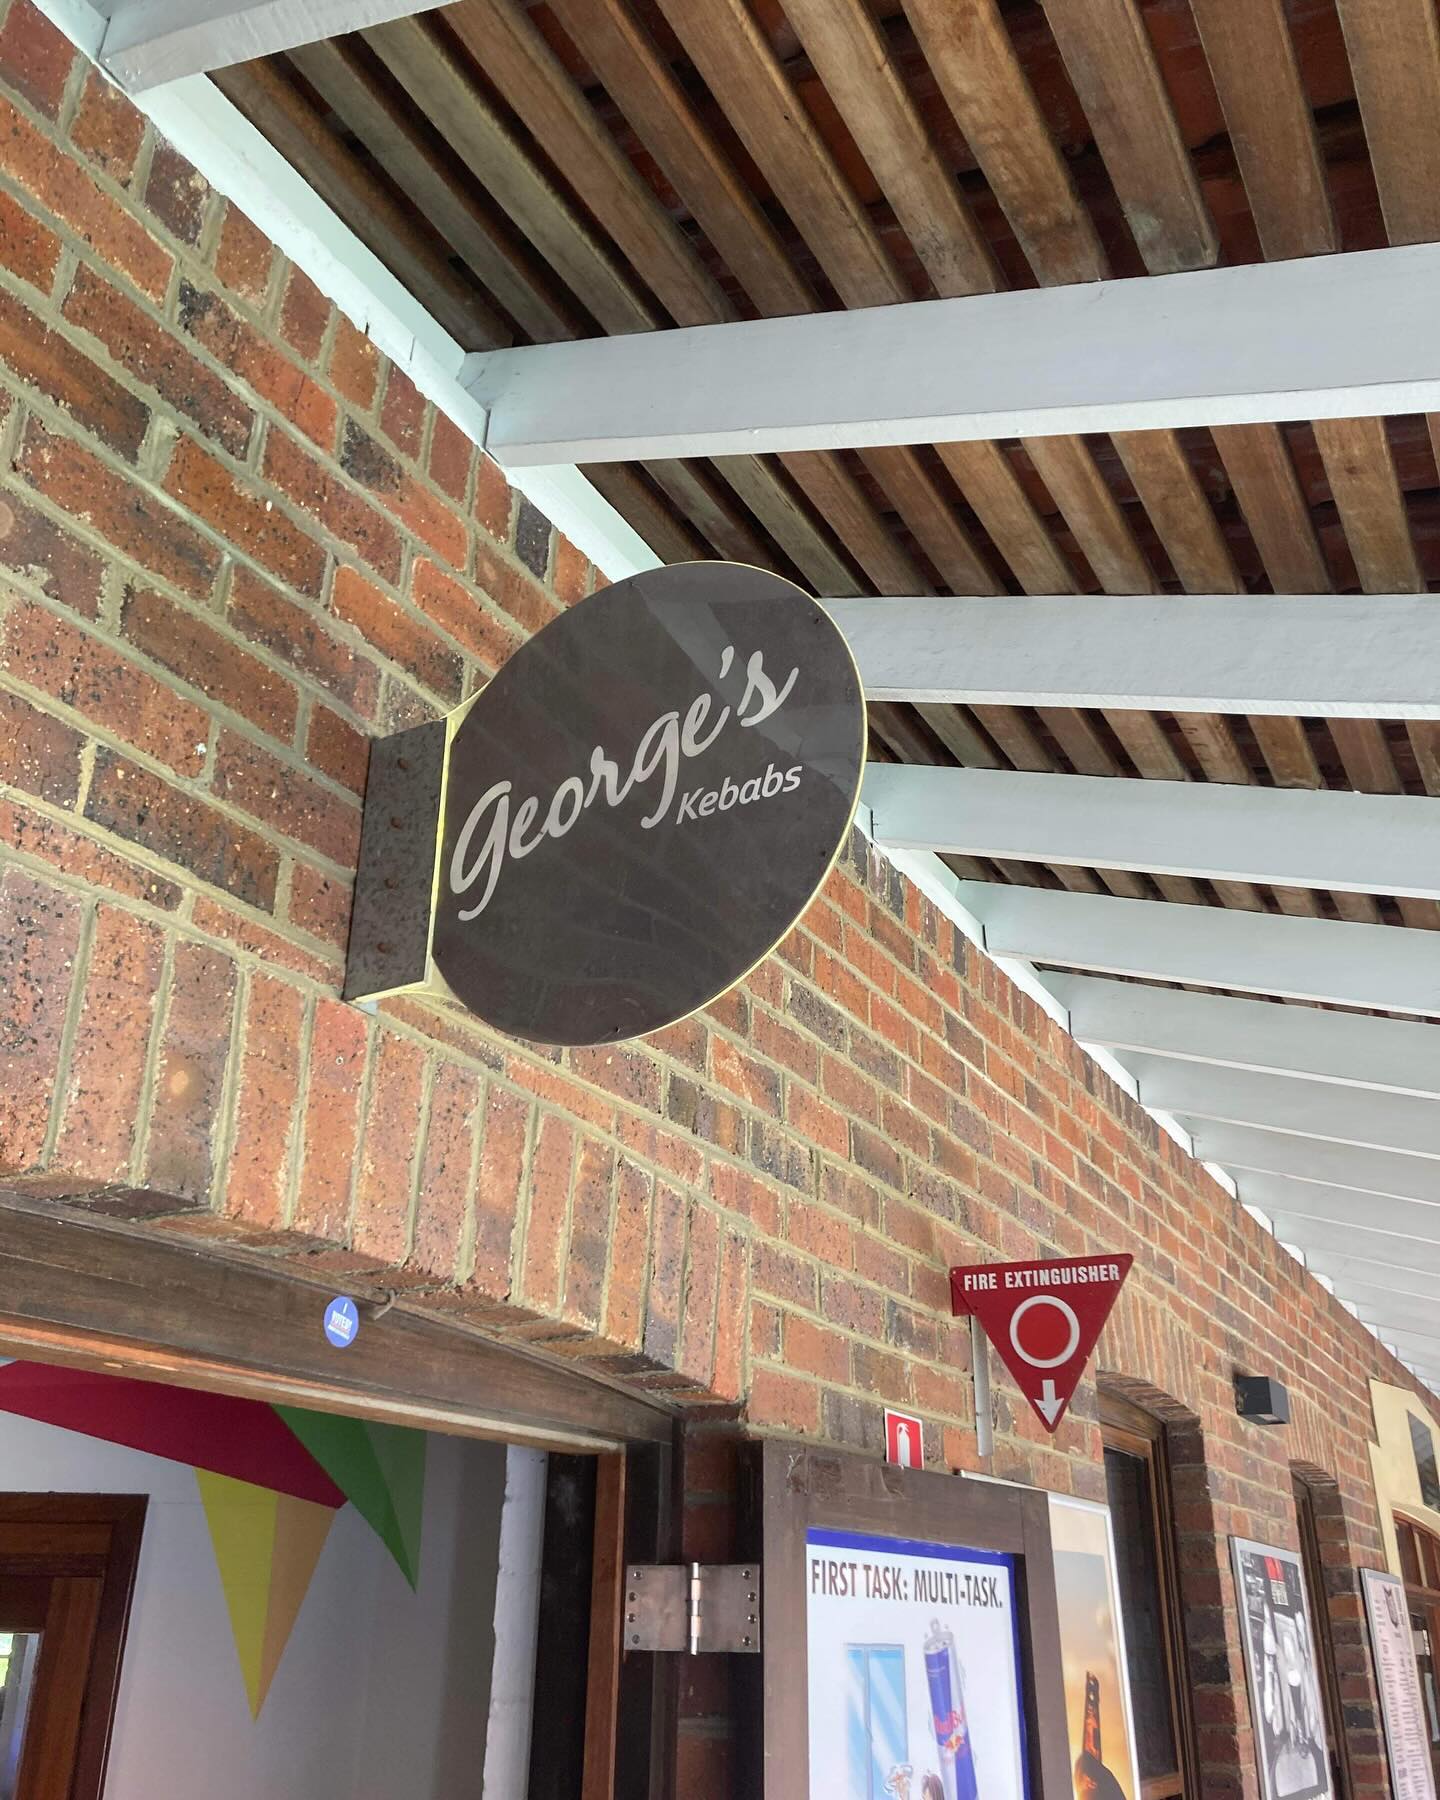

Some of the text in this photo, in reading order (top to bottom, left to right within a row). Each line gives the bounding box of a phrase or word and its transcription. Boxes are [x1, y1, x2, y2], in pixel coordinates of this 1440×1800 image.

[676, 763, 802, 825] Kebabs
[964, 1264, 1120, 1291] FIRE EXTINGUISHER
[811, 1559, 1003, 1608] FIRST TASK: MULTI-TASK.
